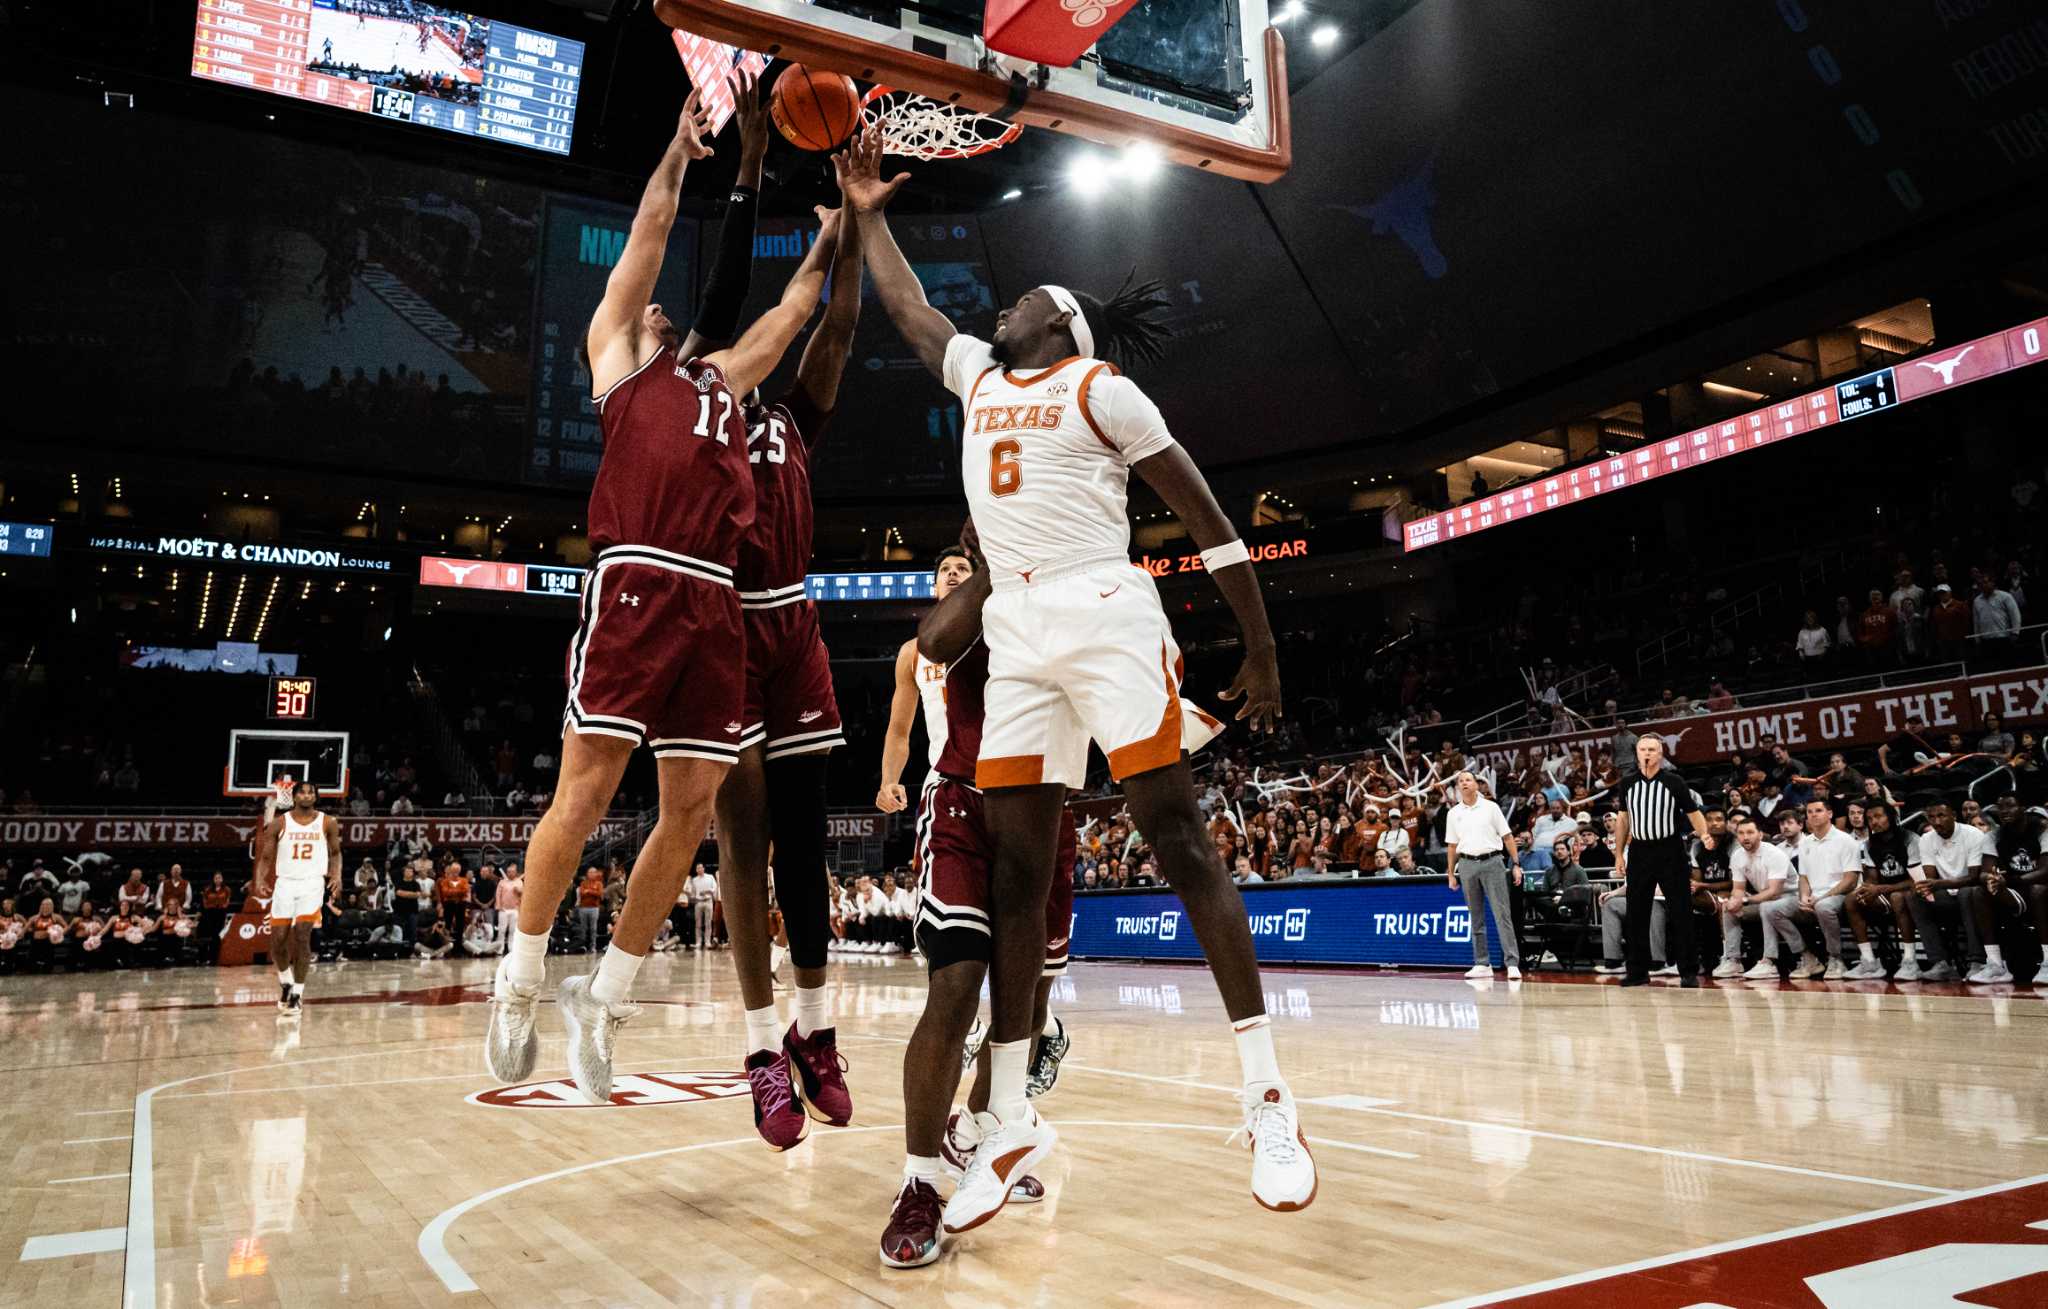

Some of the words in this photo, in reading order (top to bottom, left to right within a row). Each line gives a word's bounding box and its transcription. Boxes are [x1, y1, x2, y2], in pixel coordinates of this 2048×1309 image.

[316, 79, 328, 100] 0
[453, 109, 465, 129] 0
[579, 225, 627, 267] NM
[2023, 327, 2041, 356] 0
[1841, 382, 1859, 398] TOL:
[1876, 374, 1884, 389] 4
[1843, 397, 1873, 416] FOULS:
[1879, 391, 1887, 405] 0
[693, 390, 733, 446] 12
[973, 404, 1065, 435] TEXAS
[1722, 422, 1737, 438] AST
[1778, 404, 1794, 419] BLK
[747, 418, 786, 464] 25
[989, 438, 1023, 498] 6
[1408, 518, 1438, 538] TEXAS
[157, 537, 219, 558] MOËT
[221, 545, 237, 560] &
[241, 545, 340, 568] CHANDON
[342, 558, 391, 570] LOUNGE
[1179, 554, 1205, 572] ZE
[1250, 540, 1308, 562] UGAR
[507, 568, 518, 586] 0
[541, 572, 577, 590] 19:40
[279, 680, 311, 694] 19:40
[277, 693, 306, 715] 30
[1713, 711, 1807, 753] HOME
[1818, 703, 1862, 740] OF
[1876, 691, 1958, 732] THE
[0, 821, 84, 843] OODY
[94, 822, 210, 843] CENTER
[350, 823, 376, 842] OF
[385, 823, 432, 842] THE
[436, 823, 504, 843] TEXAS
[291, 843, 313, 860] 12
[1116, 917, 1159, 935] TRUIST
[1249, 915, 1283, 935] UIST
[1374, 913, 1442, 936] TRUIST
